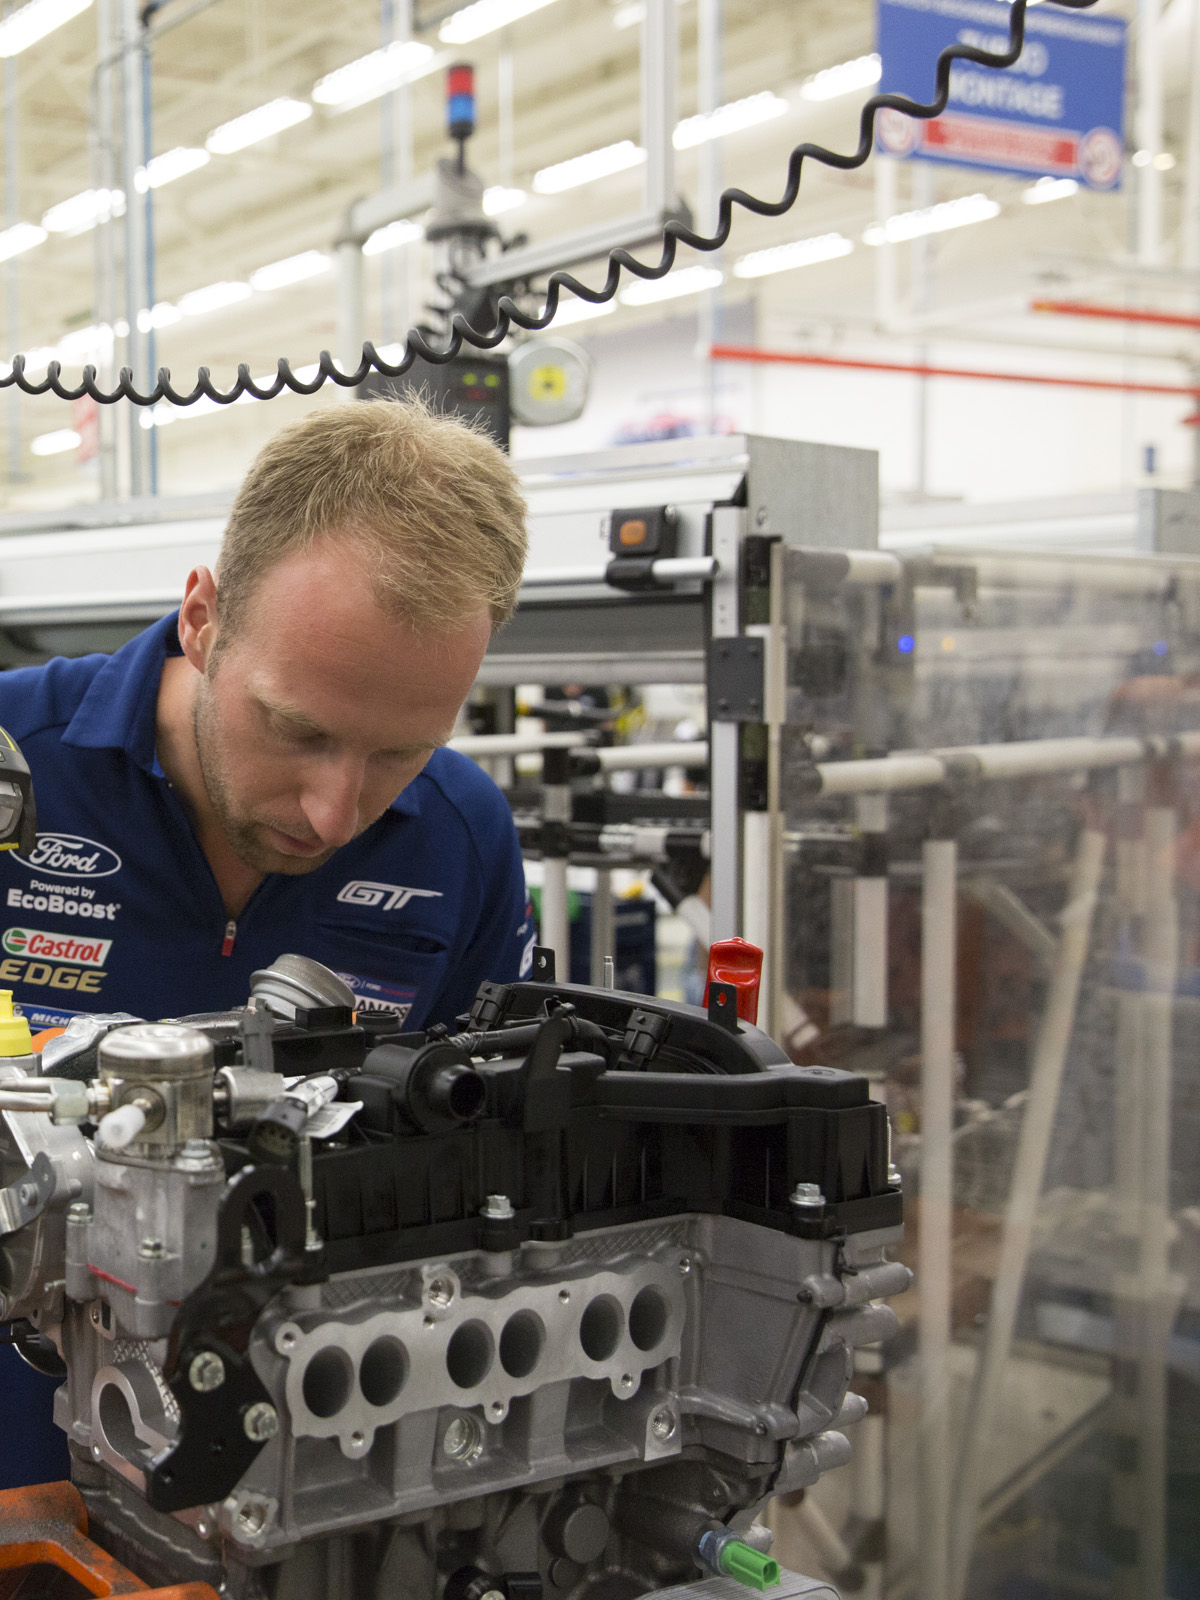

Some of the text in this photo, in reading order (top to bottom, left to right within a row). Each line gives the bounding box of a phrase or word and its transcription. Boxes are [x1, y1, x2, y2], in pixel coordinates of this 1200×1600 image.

[29, 837, 100, 872] Ford
[6, 888, 117, 920] EcoBoost
[30, 880, 95, 900] Powered by
[337, 880, 444, 911] GT
[28, 934, 103, 962] Castrol
[30, 1012, 70, 1026] MICH
